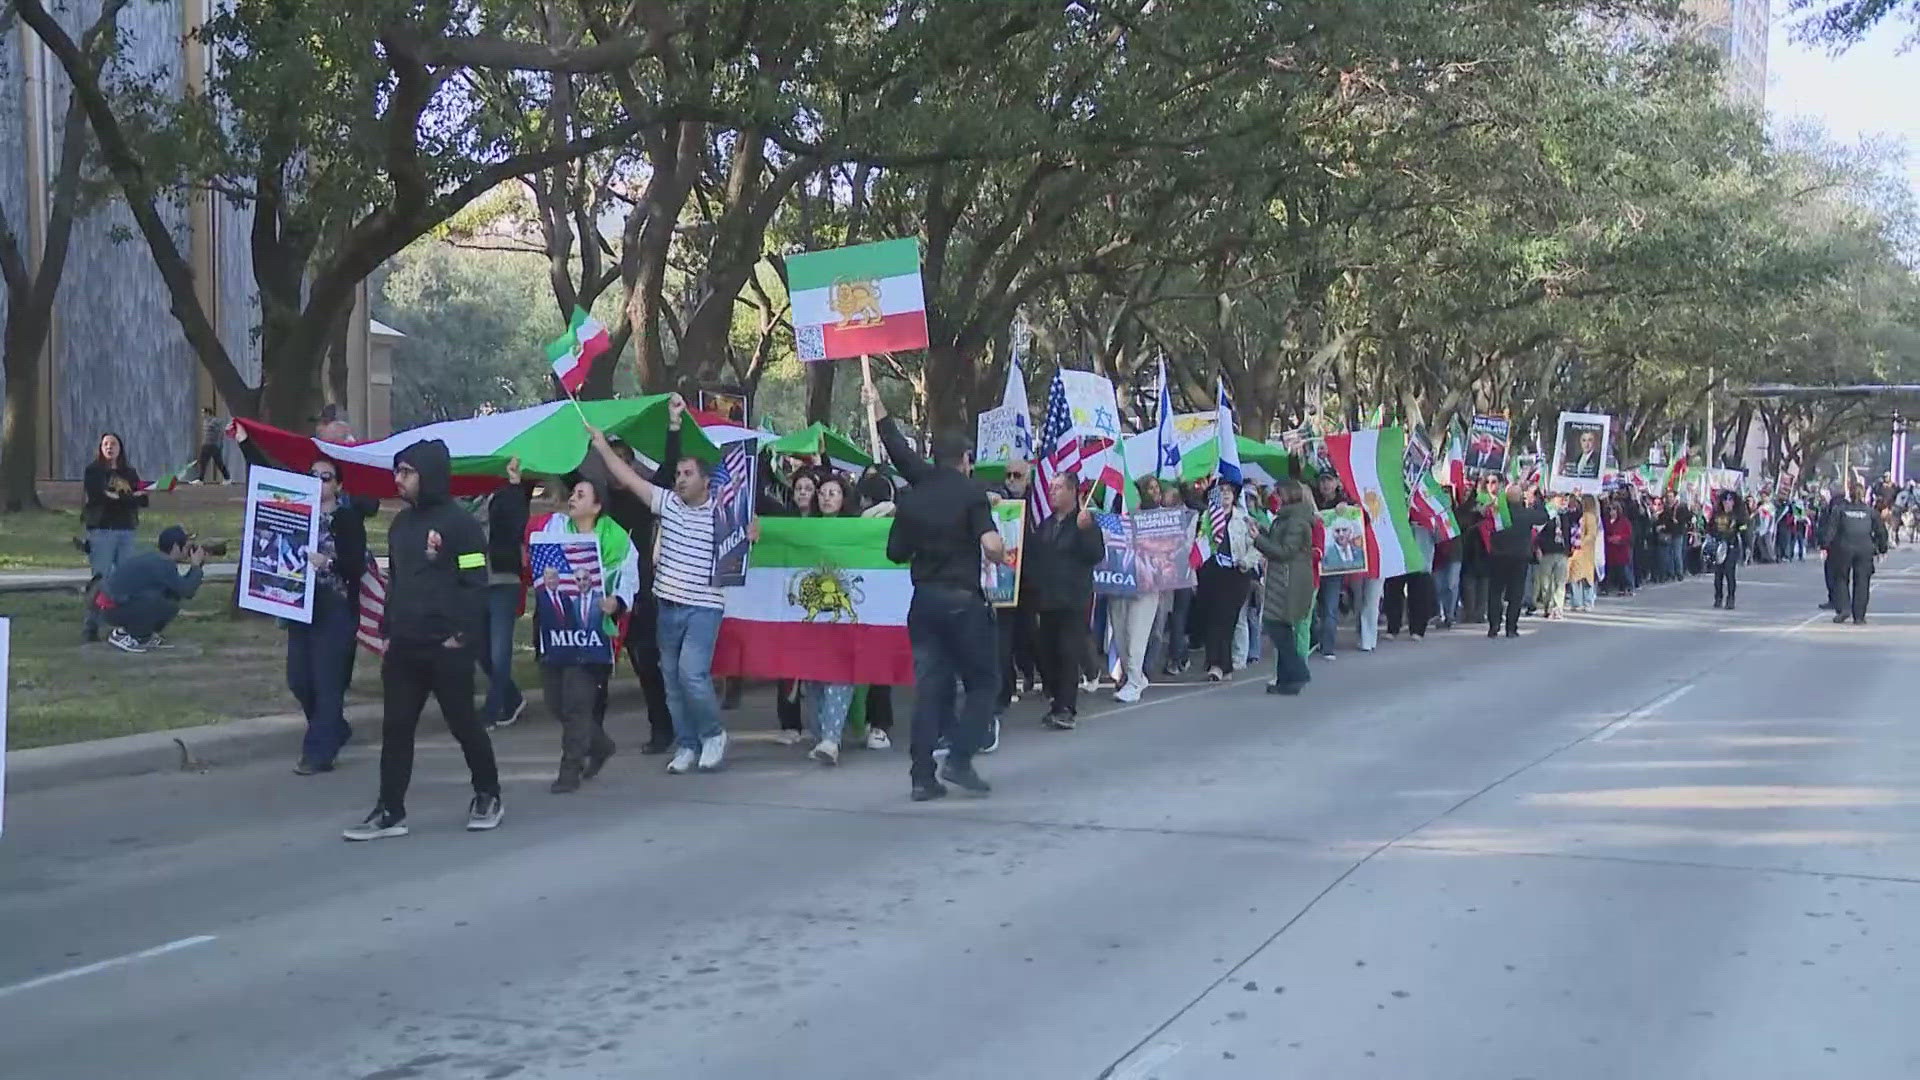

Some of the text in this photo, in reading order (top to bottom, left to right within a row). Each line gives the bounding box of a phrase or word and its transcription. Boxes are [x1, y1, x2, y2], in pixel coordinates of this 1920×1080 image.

[719, 526, 746, 560] MIGA
[1093, 570, 1136, 586] MIGA
[550, 630, 604, 647] MIGA
